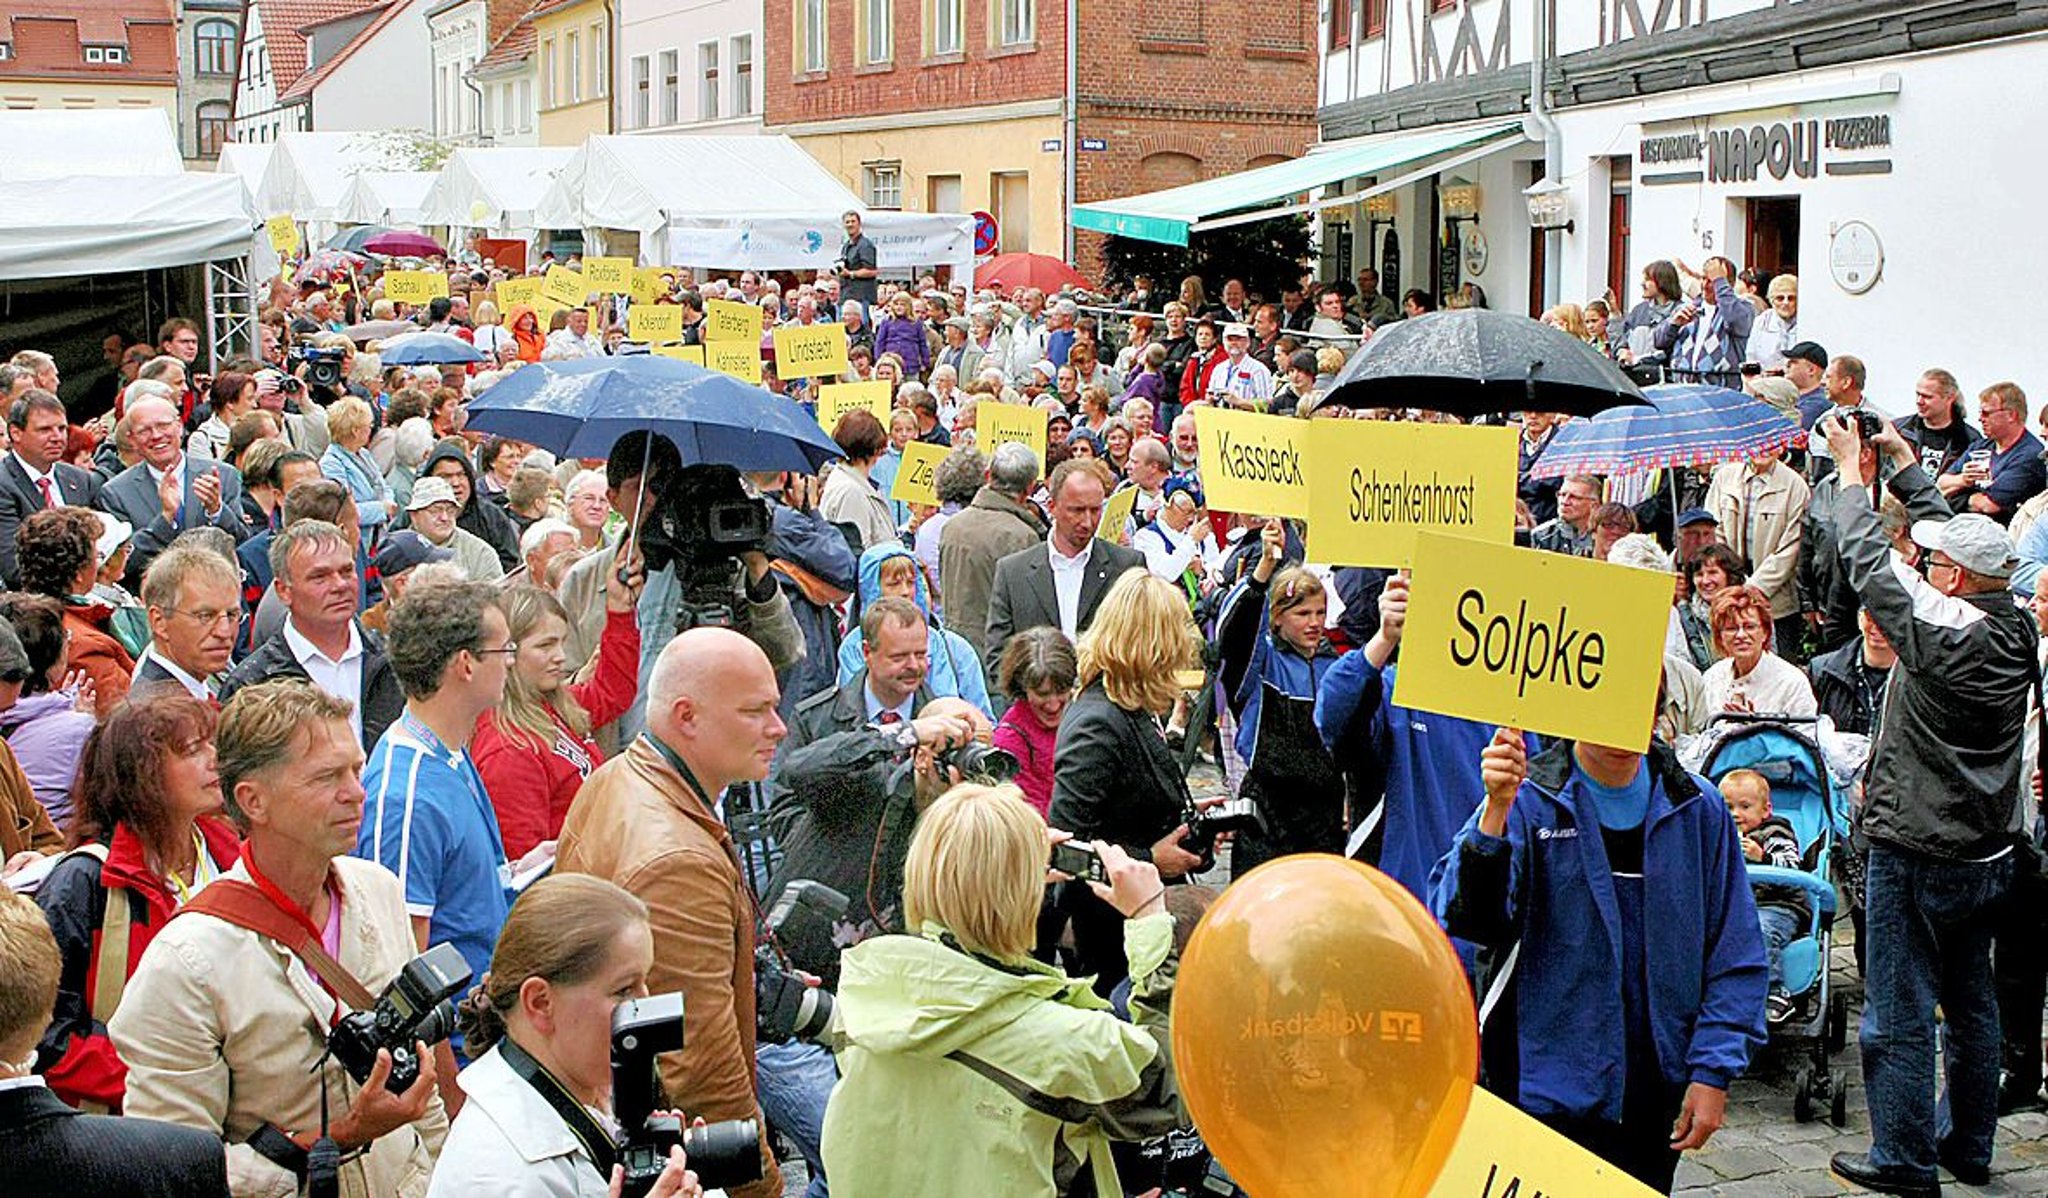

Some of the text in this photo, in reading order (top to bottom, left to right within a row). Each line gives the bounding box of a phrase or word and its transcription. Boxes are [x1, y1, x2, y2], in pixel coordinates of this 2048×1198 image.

[1708, 120, 1818, 184] NAPOLI
[1825, 114, 1891, 149] PIZZERIA
[1702, 230, 1714, 251] 15
[391, 278, 420, 294] Sachau
[787, 336, 834, 364] Lindstedt
[1216, 429, 1304, 487] Kassieck
[1350, 467, 1475, 526] Schenkenhorst
[1450, 588, 1606, 698] Solpke
